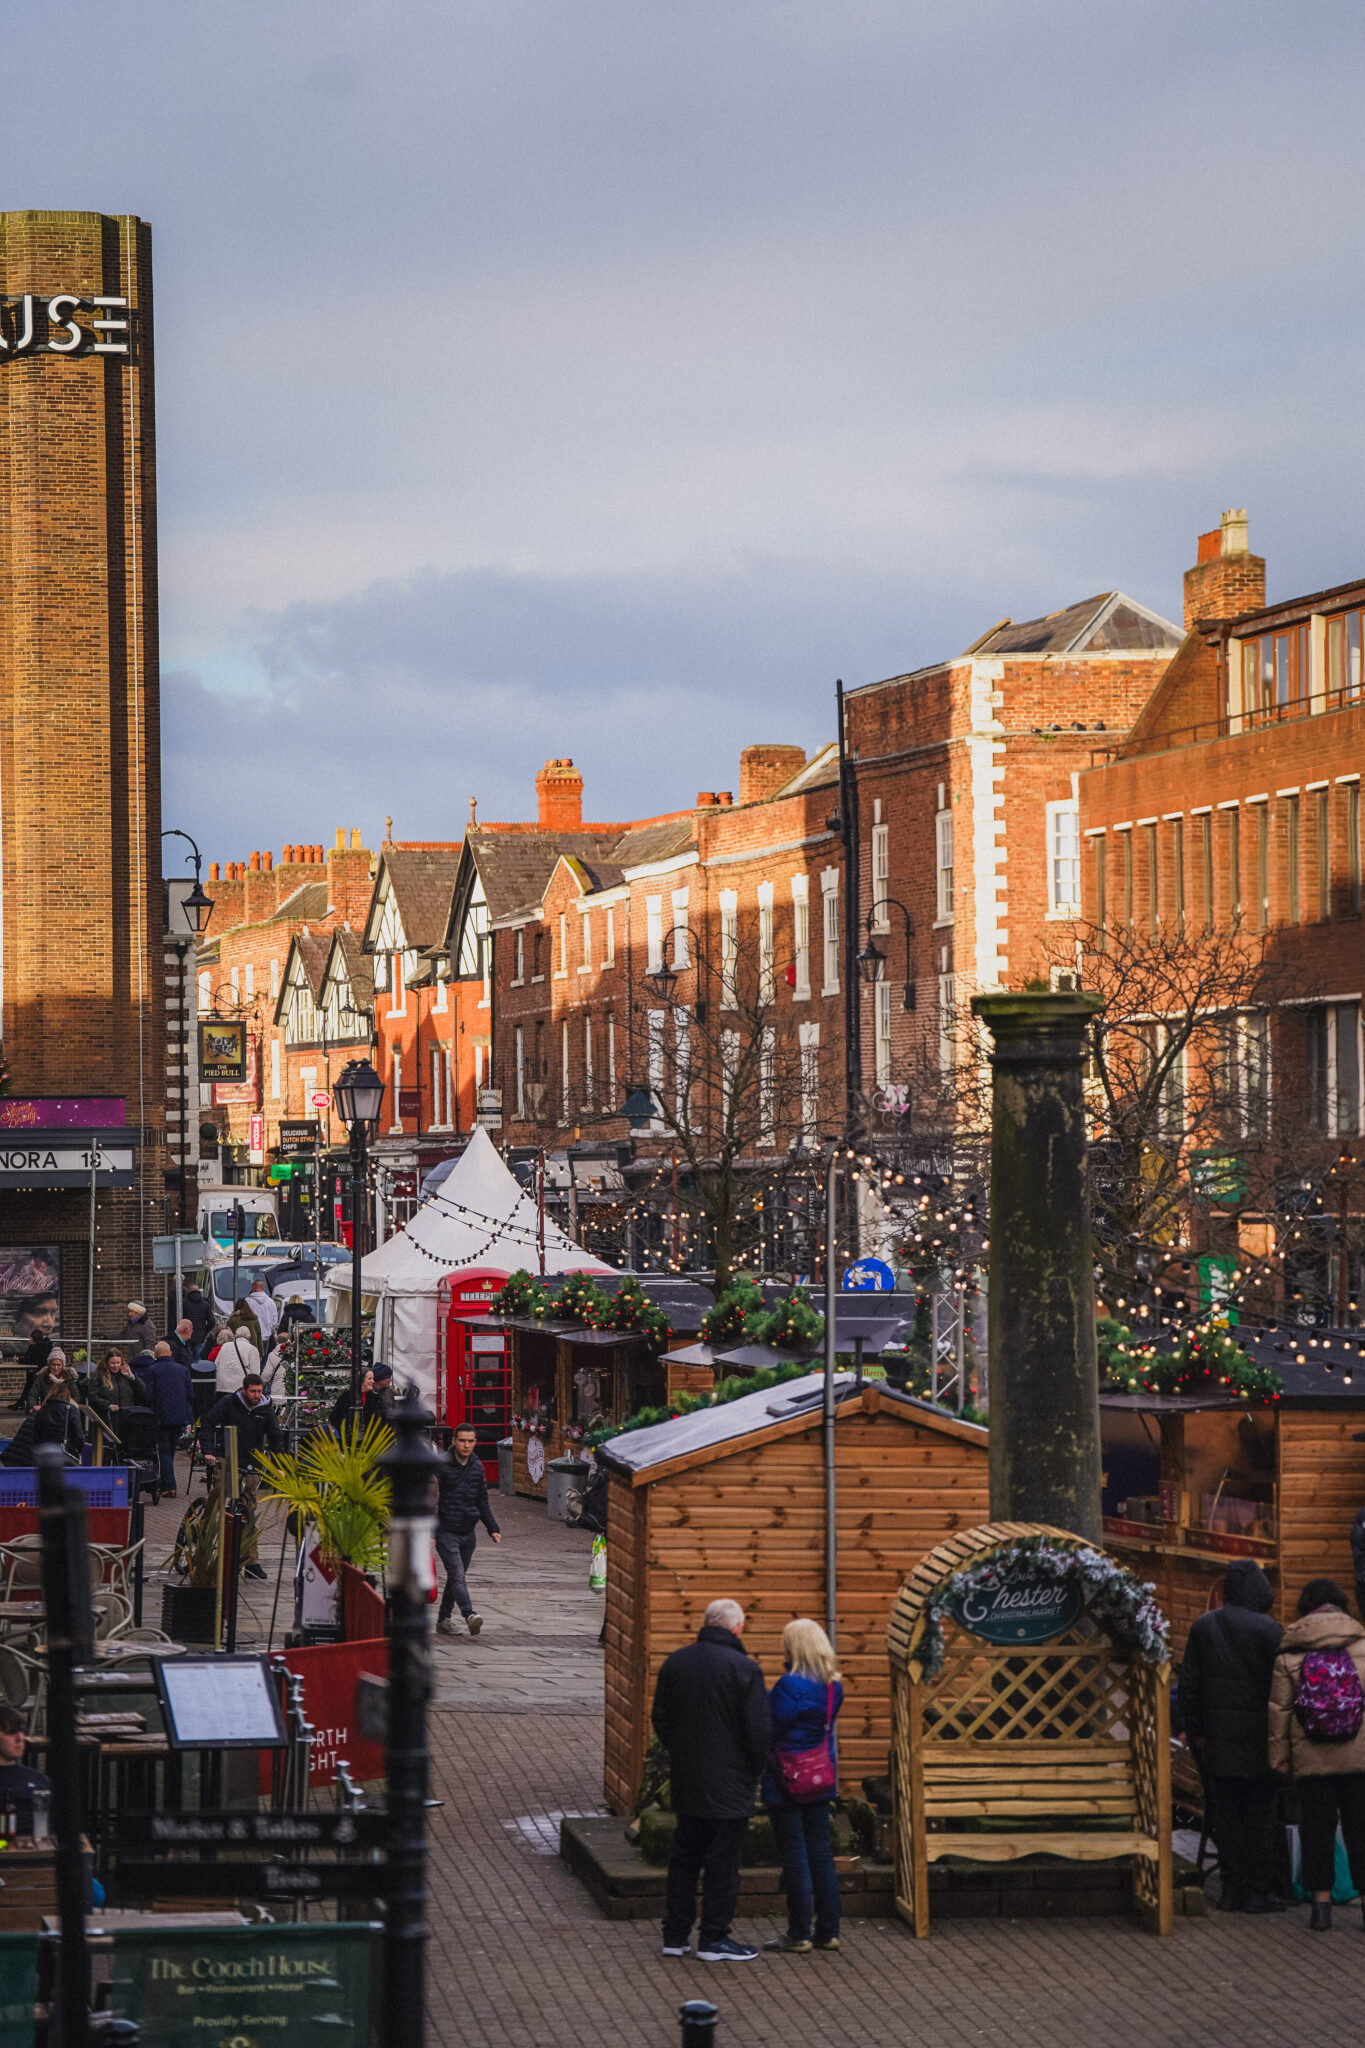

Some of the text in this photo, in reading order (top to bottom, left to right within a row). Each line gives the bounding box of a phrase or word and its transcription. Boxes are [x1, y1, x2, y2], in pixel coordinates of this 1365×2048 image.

[282, 1129, 308, 1137] DELICIOUS
[81, 1152, 101, 1168] 18
[962, 1579, 1069, 1622] Chester
[1031, 1606, 1063, 1618] MARKET
[151, 1954, 335, 1980] The Coach House
[177, 1984, 196, 1995] Bar
[193, 2014, 289, 2027] Proudly Serving
